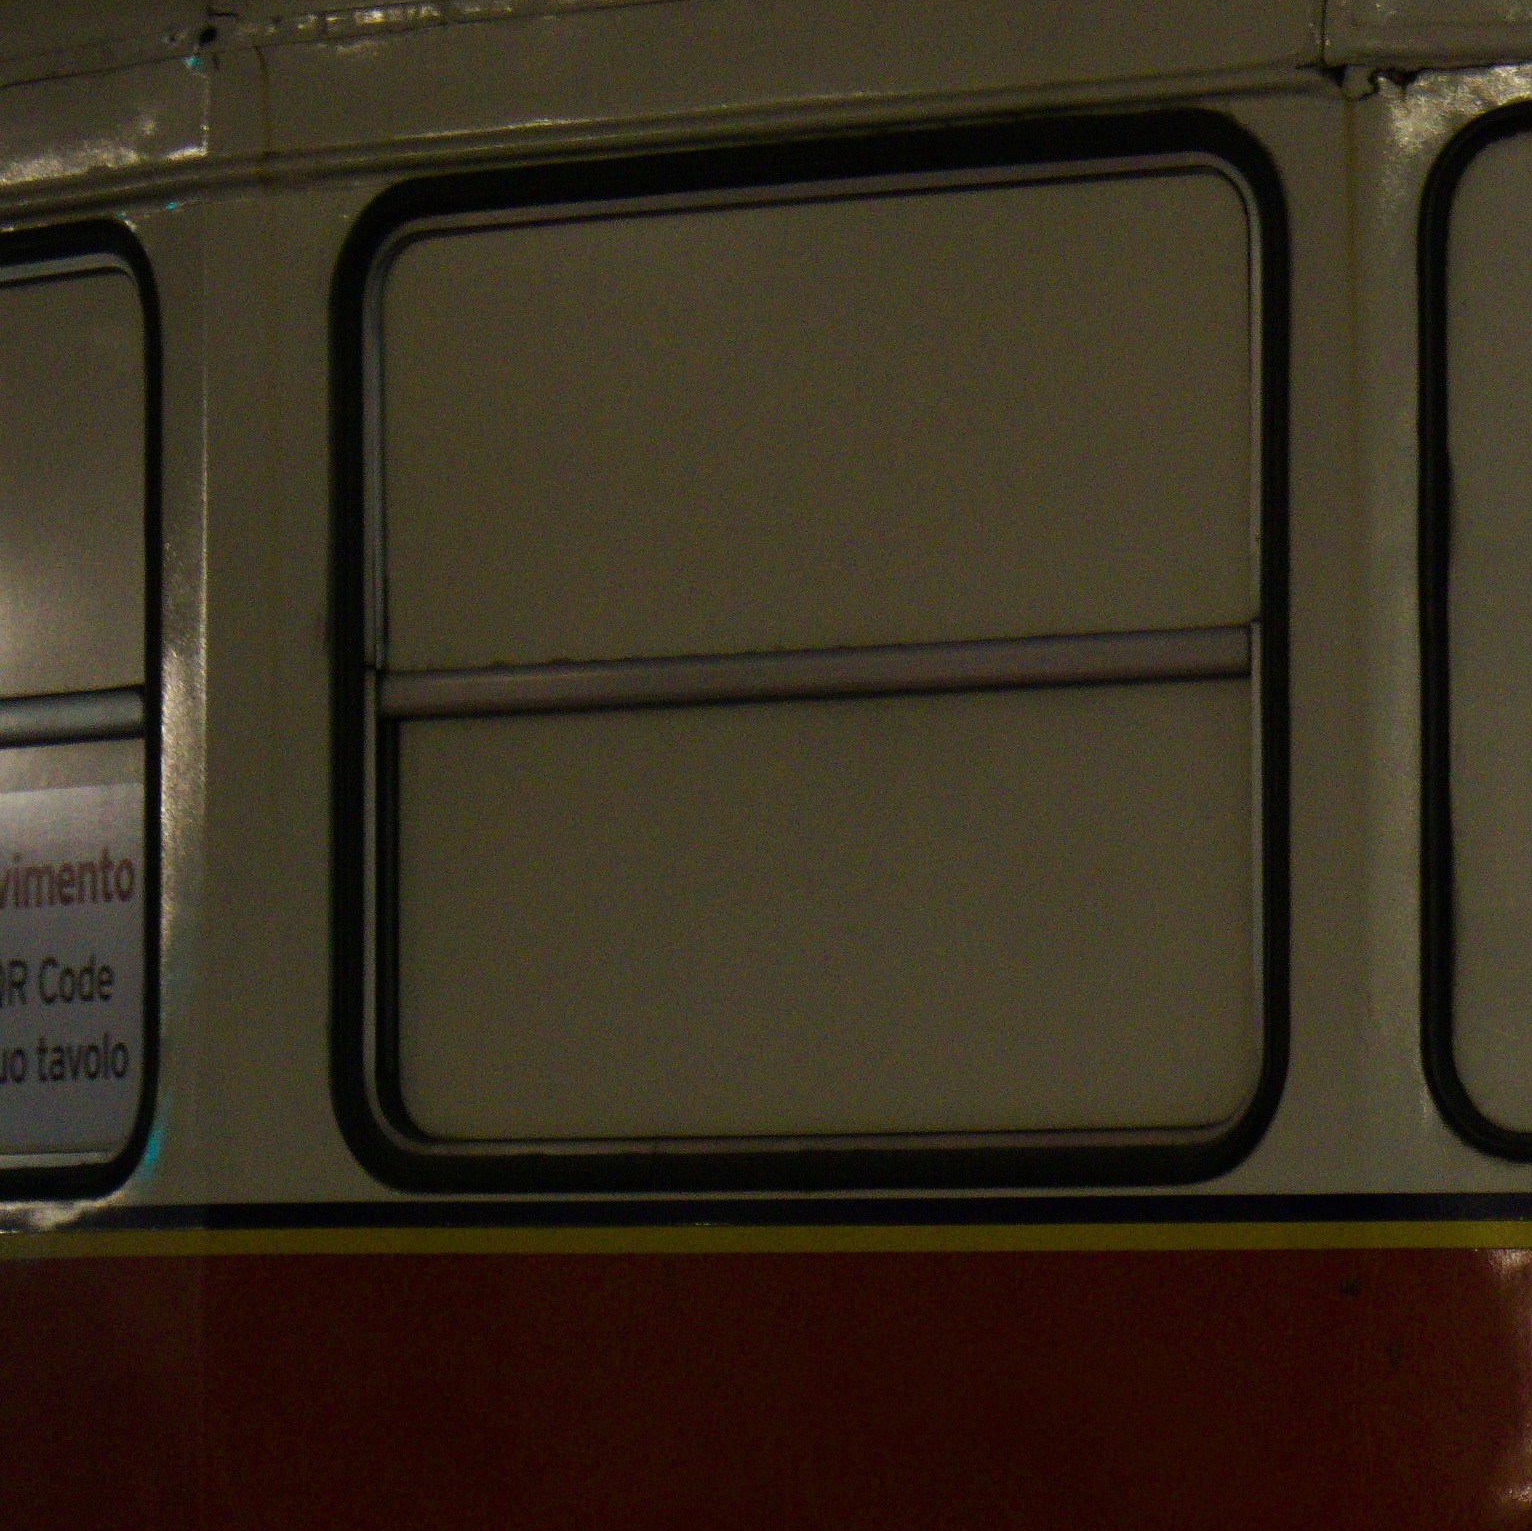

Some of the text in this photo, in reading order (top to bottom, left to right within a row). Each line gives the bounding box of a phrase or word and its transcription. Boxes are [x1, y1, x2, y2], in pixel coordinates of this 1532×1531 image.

[0, 954, 114, 1008] R Code
[36, 1031, 130, 1083] tavolo
